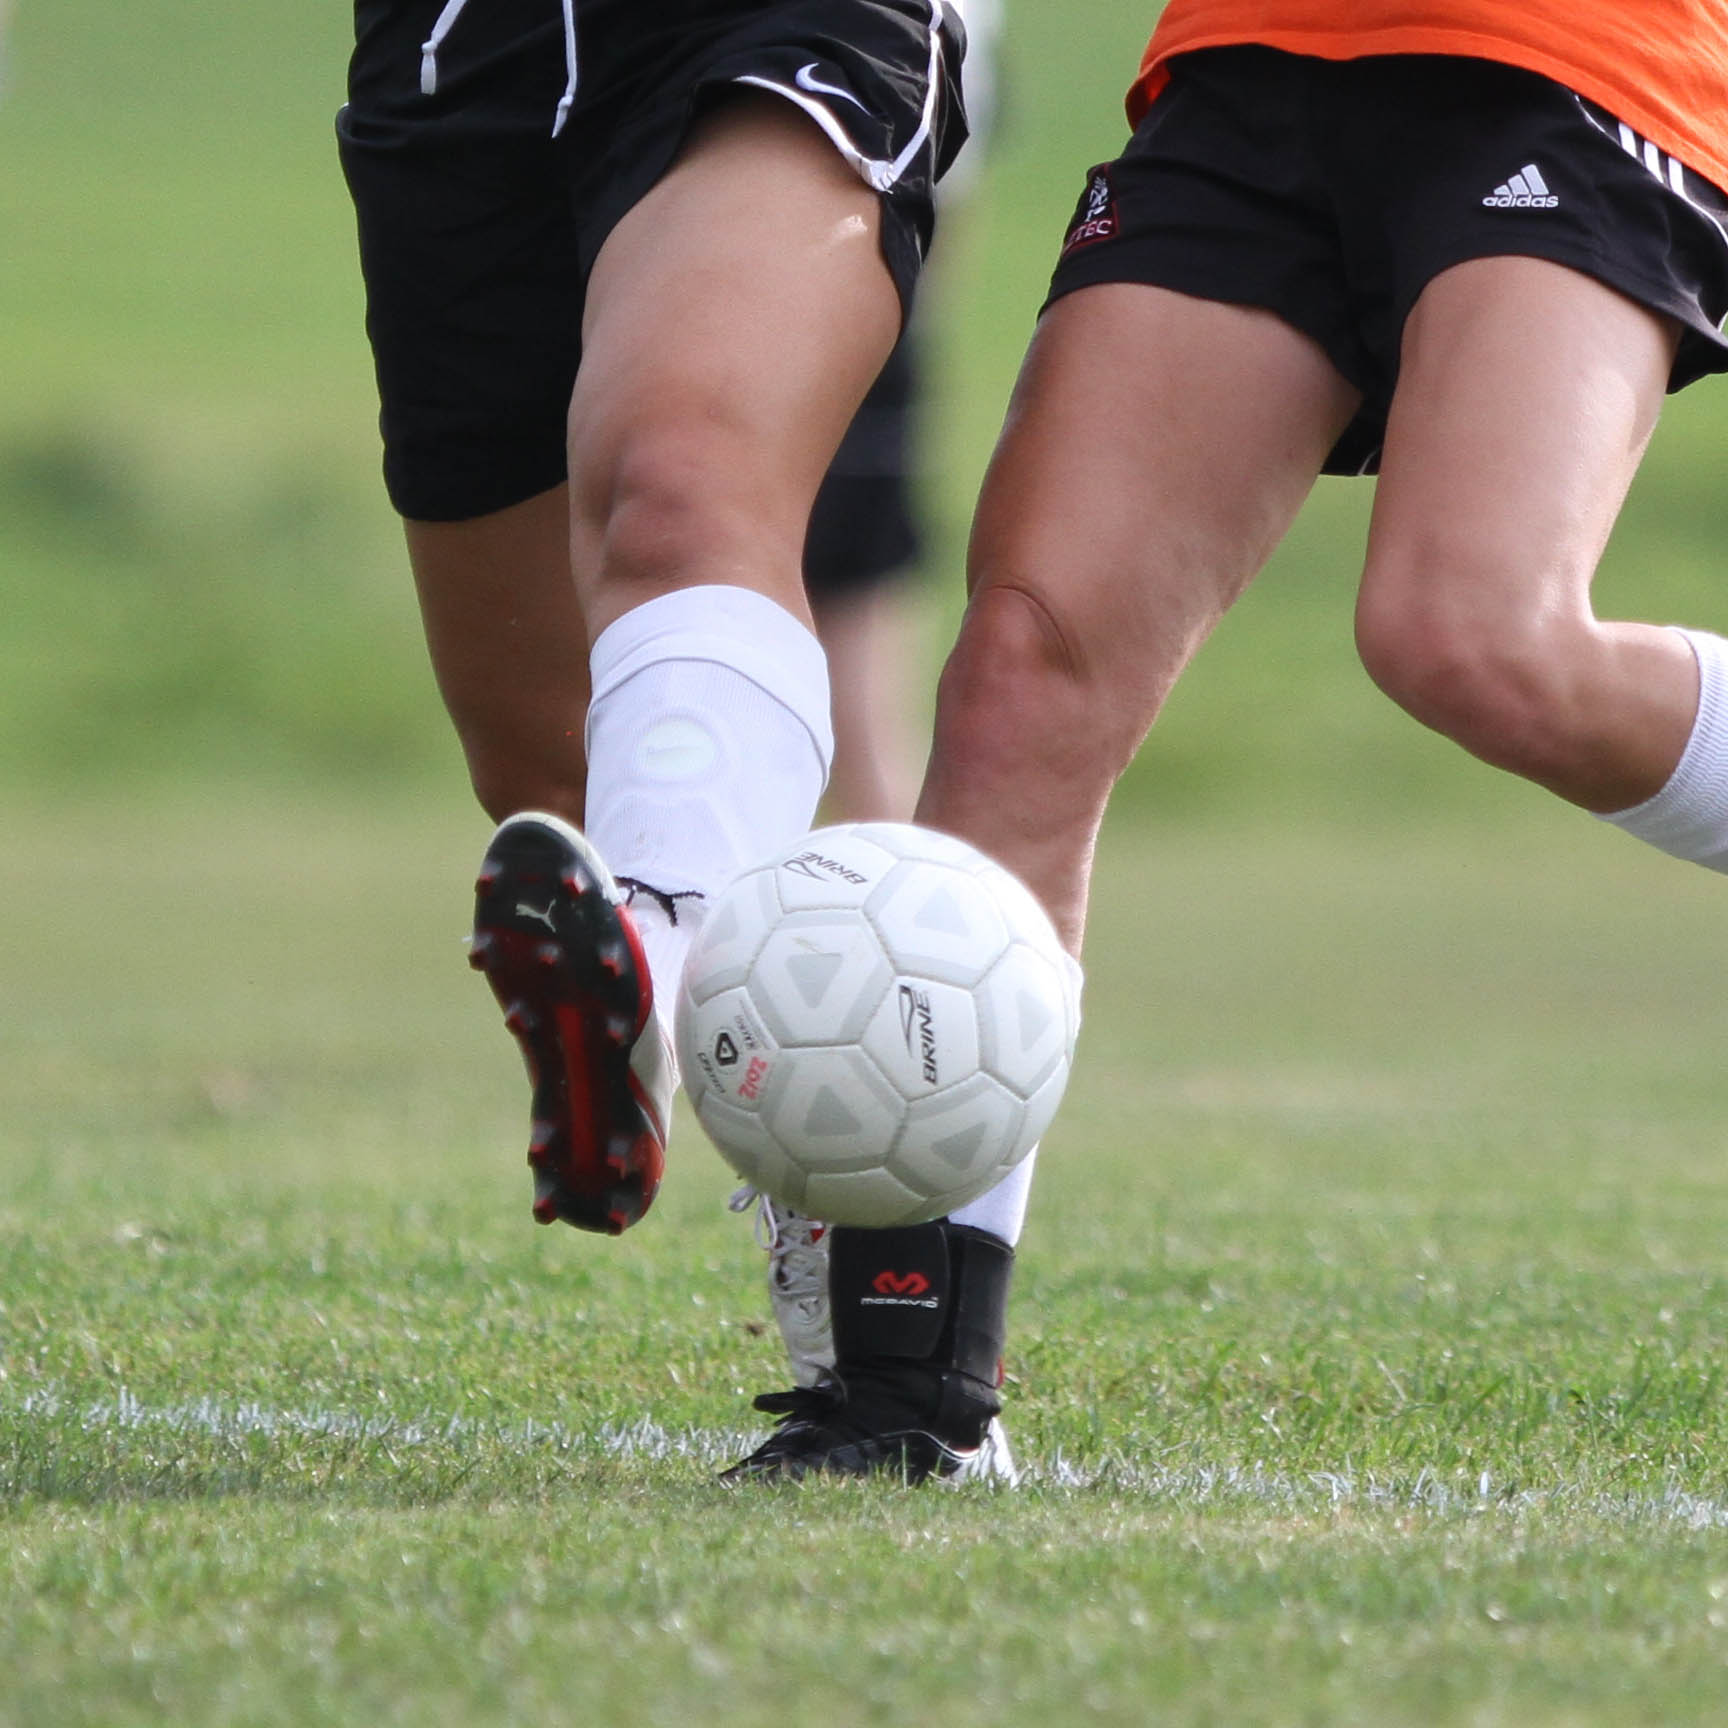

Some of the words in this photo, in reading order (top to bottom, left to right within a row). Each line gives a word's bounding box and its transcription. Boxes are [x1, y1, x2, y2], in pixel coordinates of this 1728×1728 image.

[1482, 193, 1559, 208] adidas
[793, 851, 869, 884] BRINE
[913, 989, 938, 1086] BRINE
